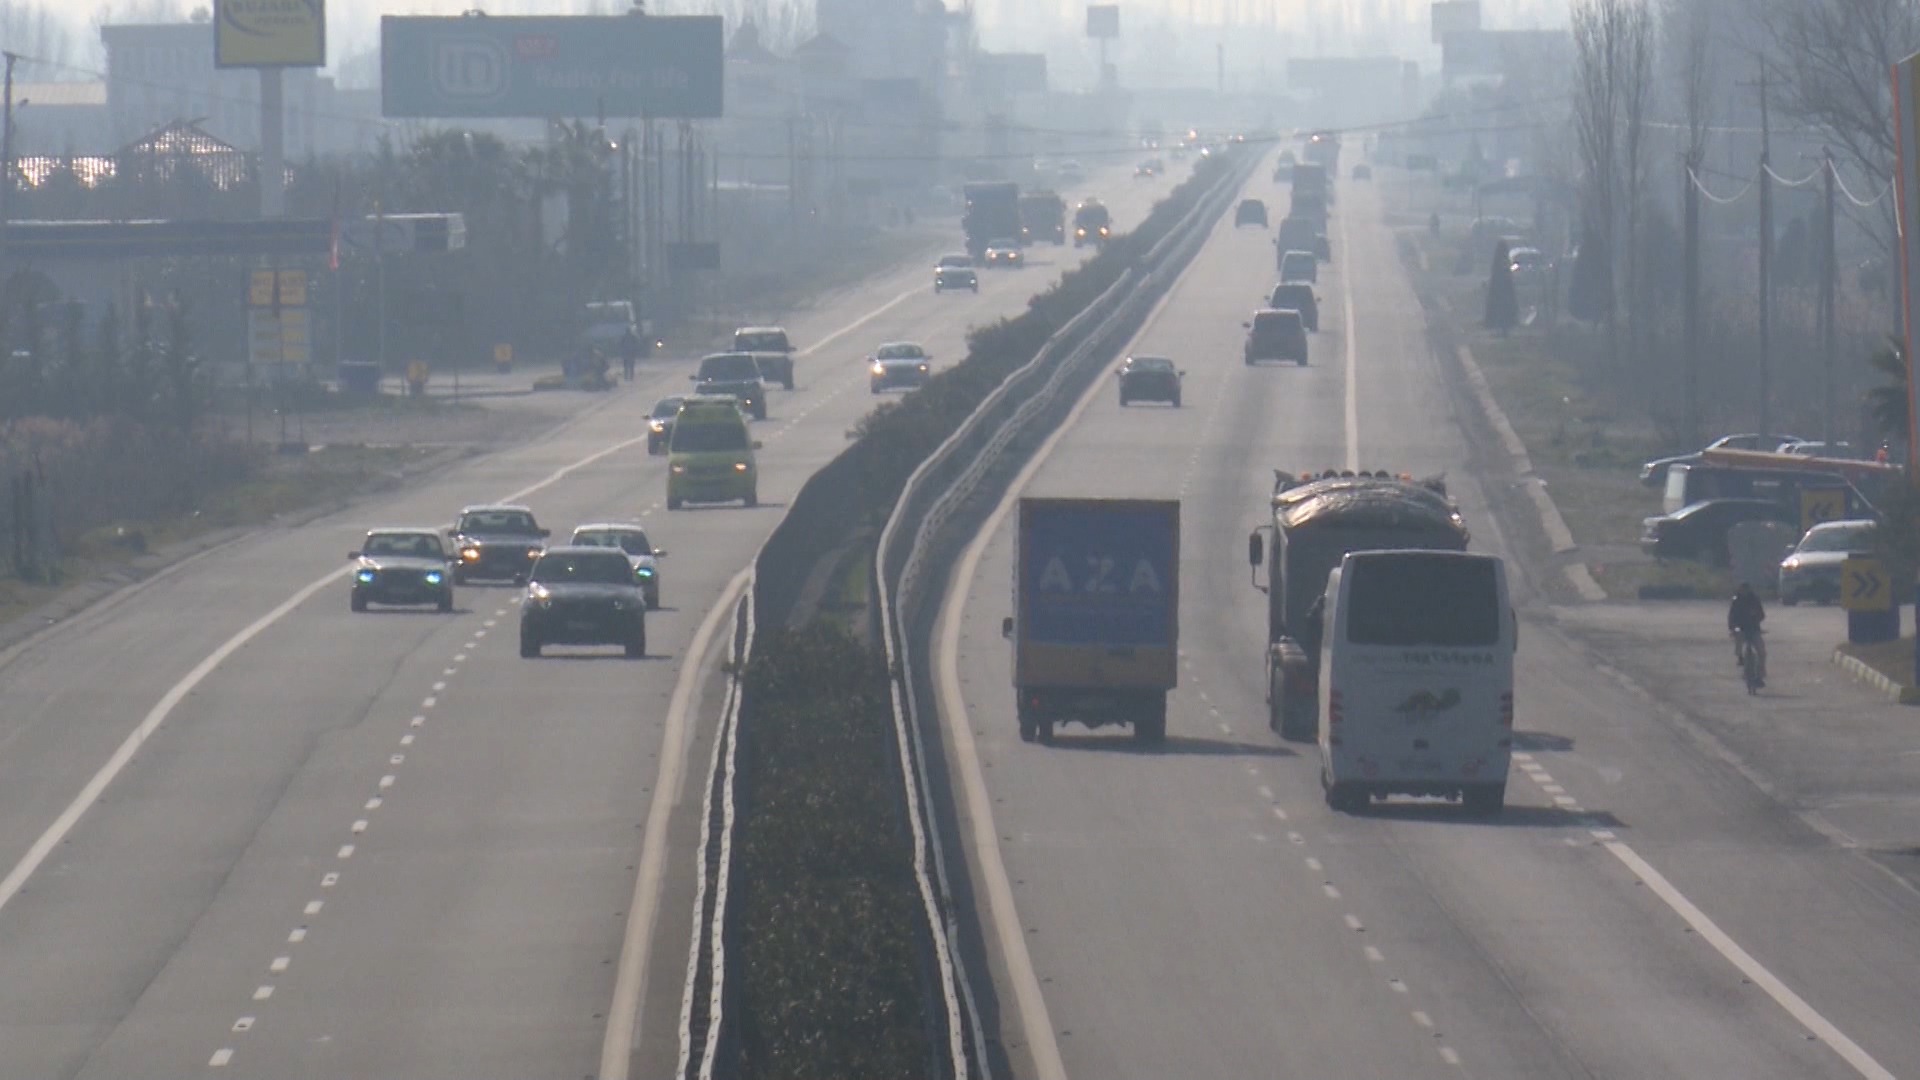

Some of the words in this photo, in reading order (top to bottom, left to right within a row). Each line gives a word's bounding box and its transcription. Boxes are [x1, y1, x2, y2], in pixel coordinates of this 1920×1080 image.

[536, 64, 601, 88] Radio
[609, 64, 647, 88] for
[651, 65, 689, 90] life
